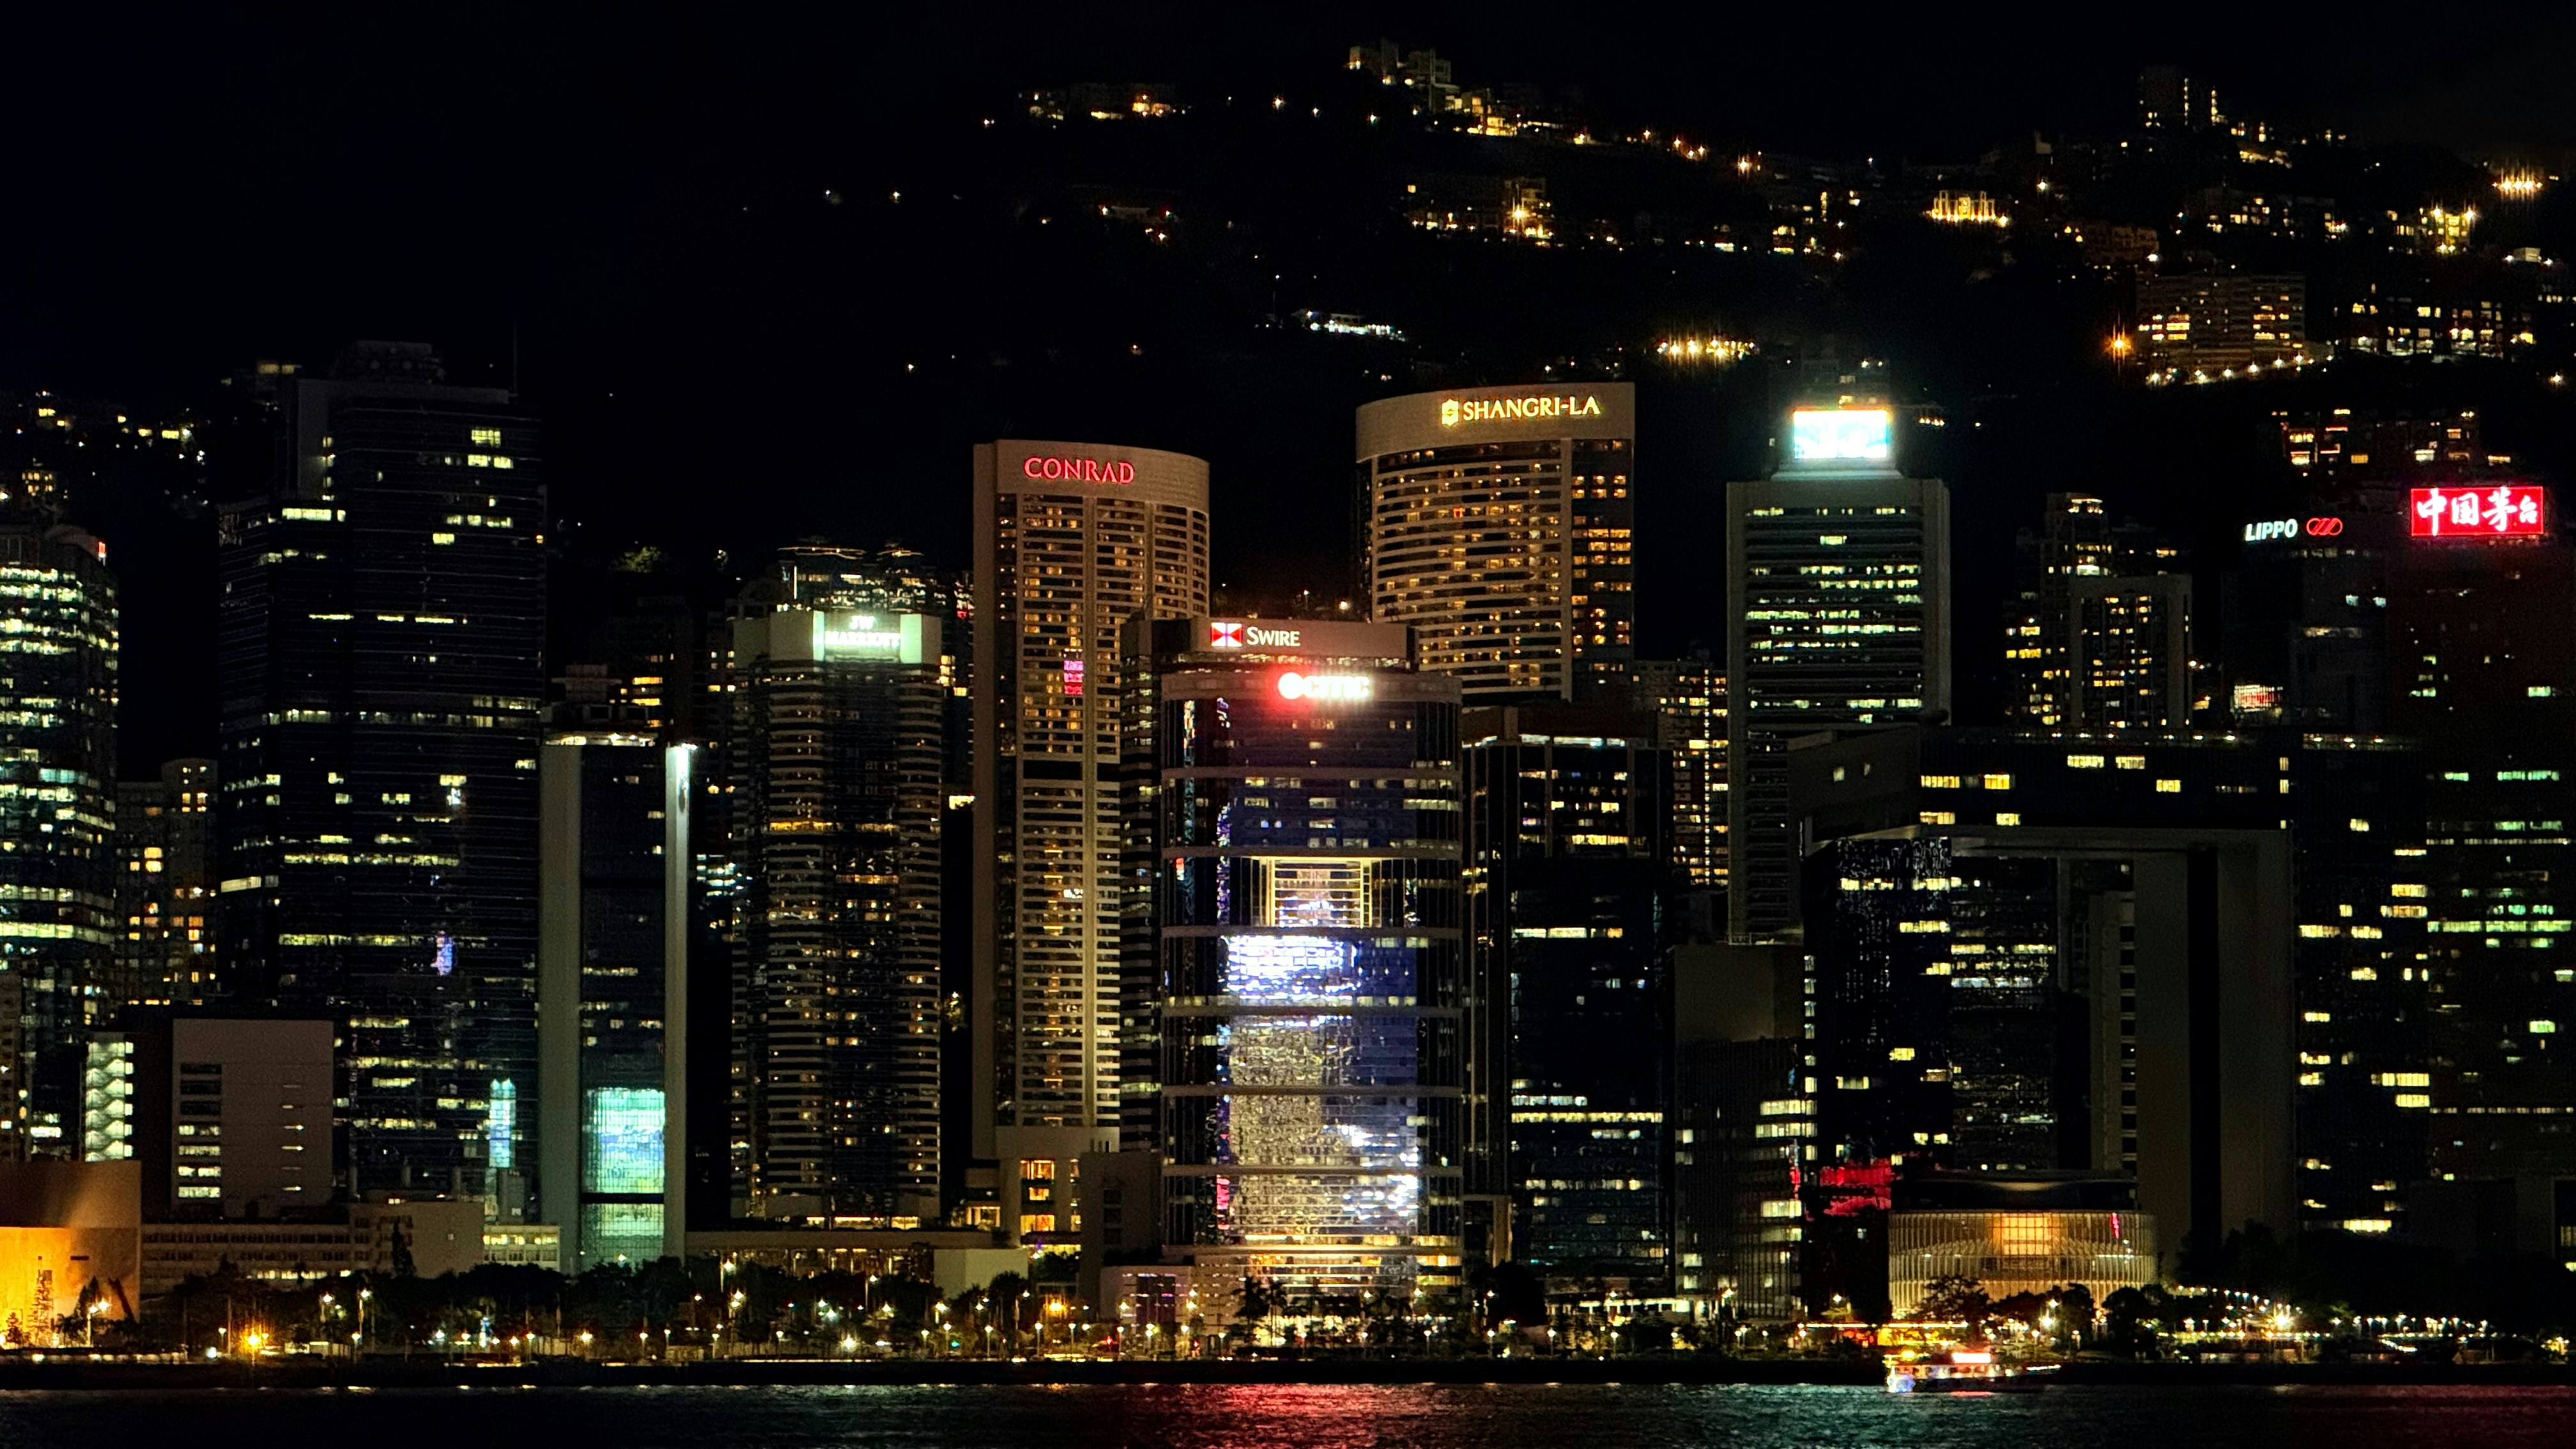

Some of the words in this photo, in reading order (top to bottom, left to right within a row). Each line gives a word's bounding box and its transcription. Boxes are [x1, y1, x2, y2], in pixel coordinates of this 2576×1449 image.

[1463, 396, 1600, 421] SHANGRI-LA
[1024, 457, 1135, 484] CONRAD
[2417, 487, 2537, 535] 中国茅台
[2245, 518, 2298, 541] LIPPO
